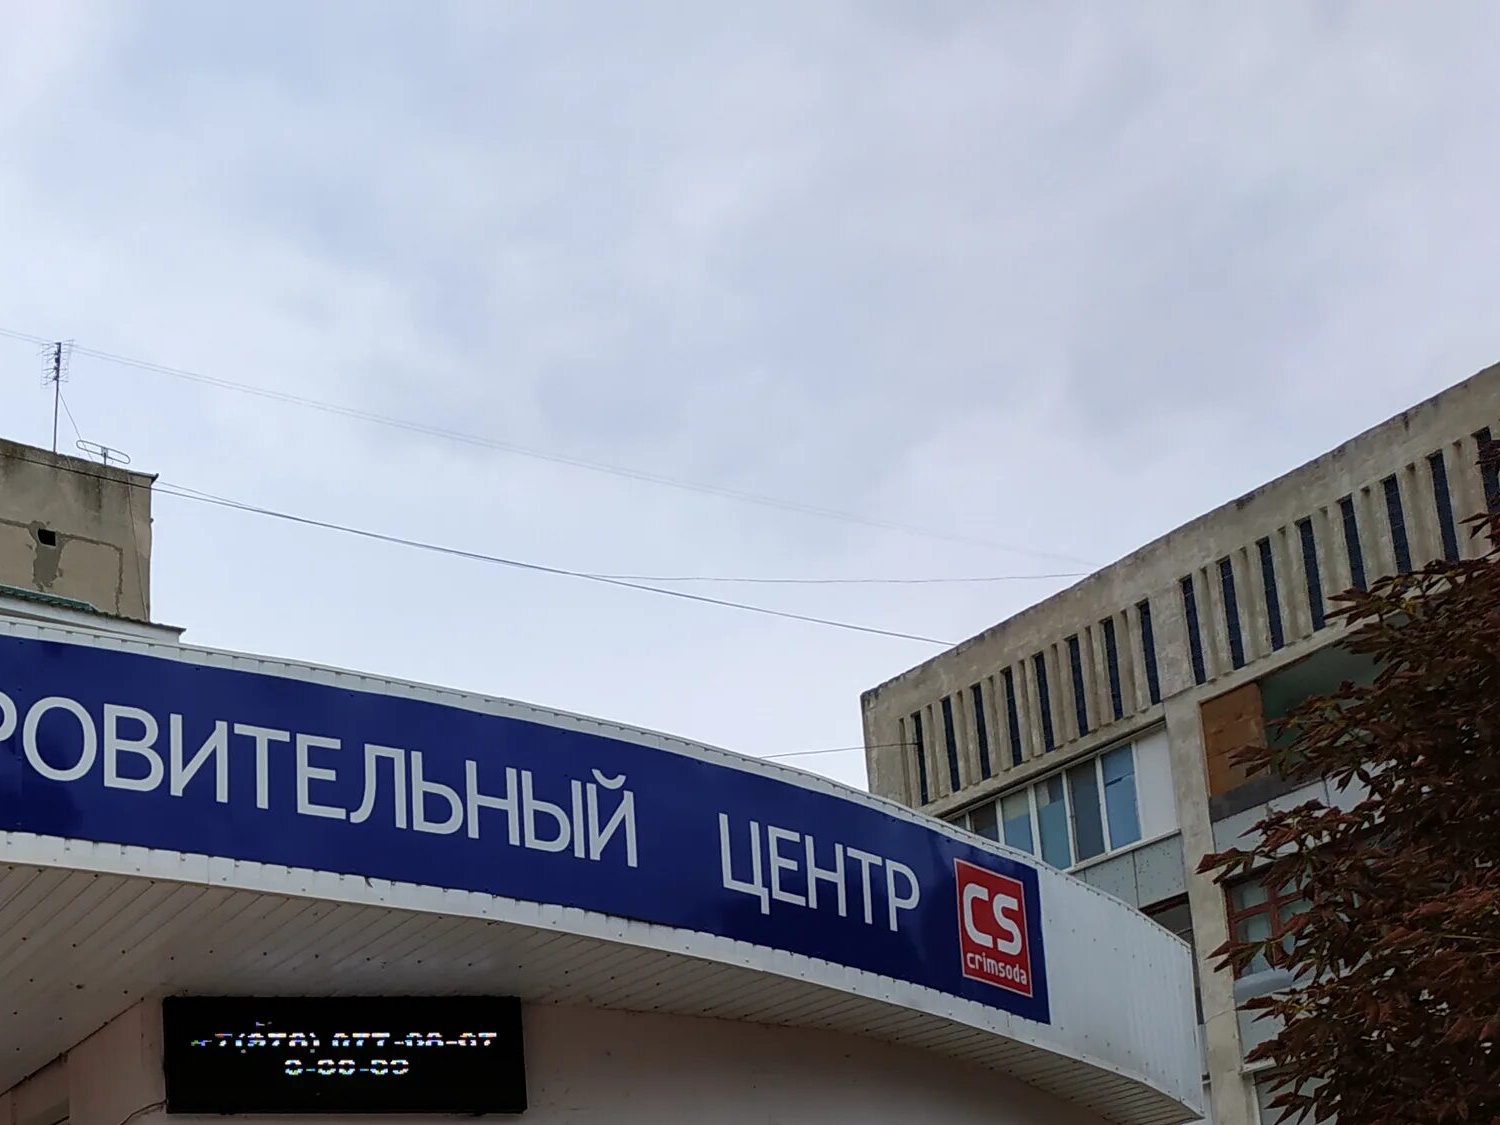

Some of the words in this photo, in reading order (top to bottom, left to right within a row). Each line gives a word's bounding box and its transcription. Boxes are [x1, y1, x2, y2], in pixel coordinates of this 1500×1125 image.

[718, 812, 921, 932] ЦЕНТР
[962, 882, 1023, 956] CS
[966, 952, 1028, 985] crimsoda
